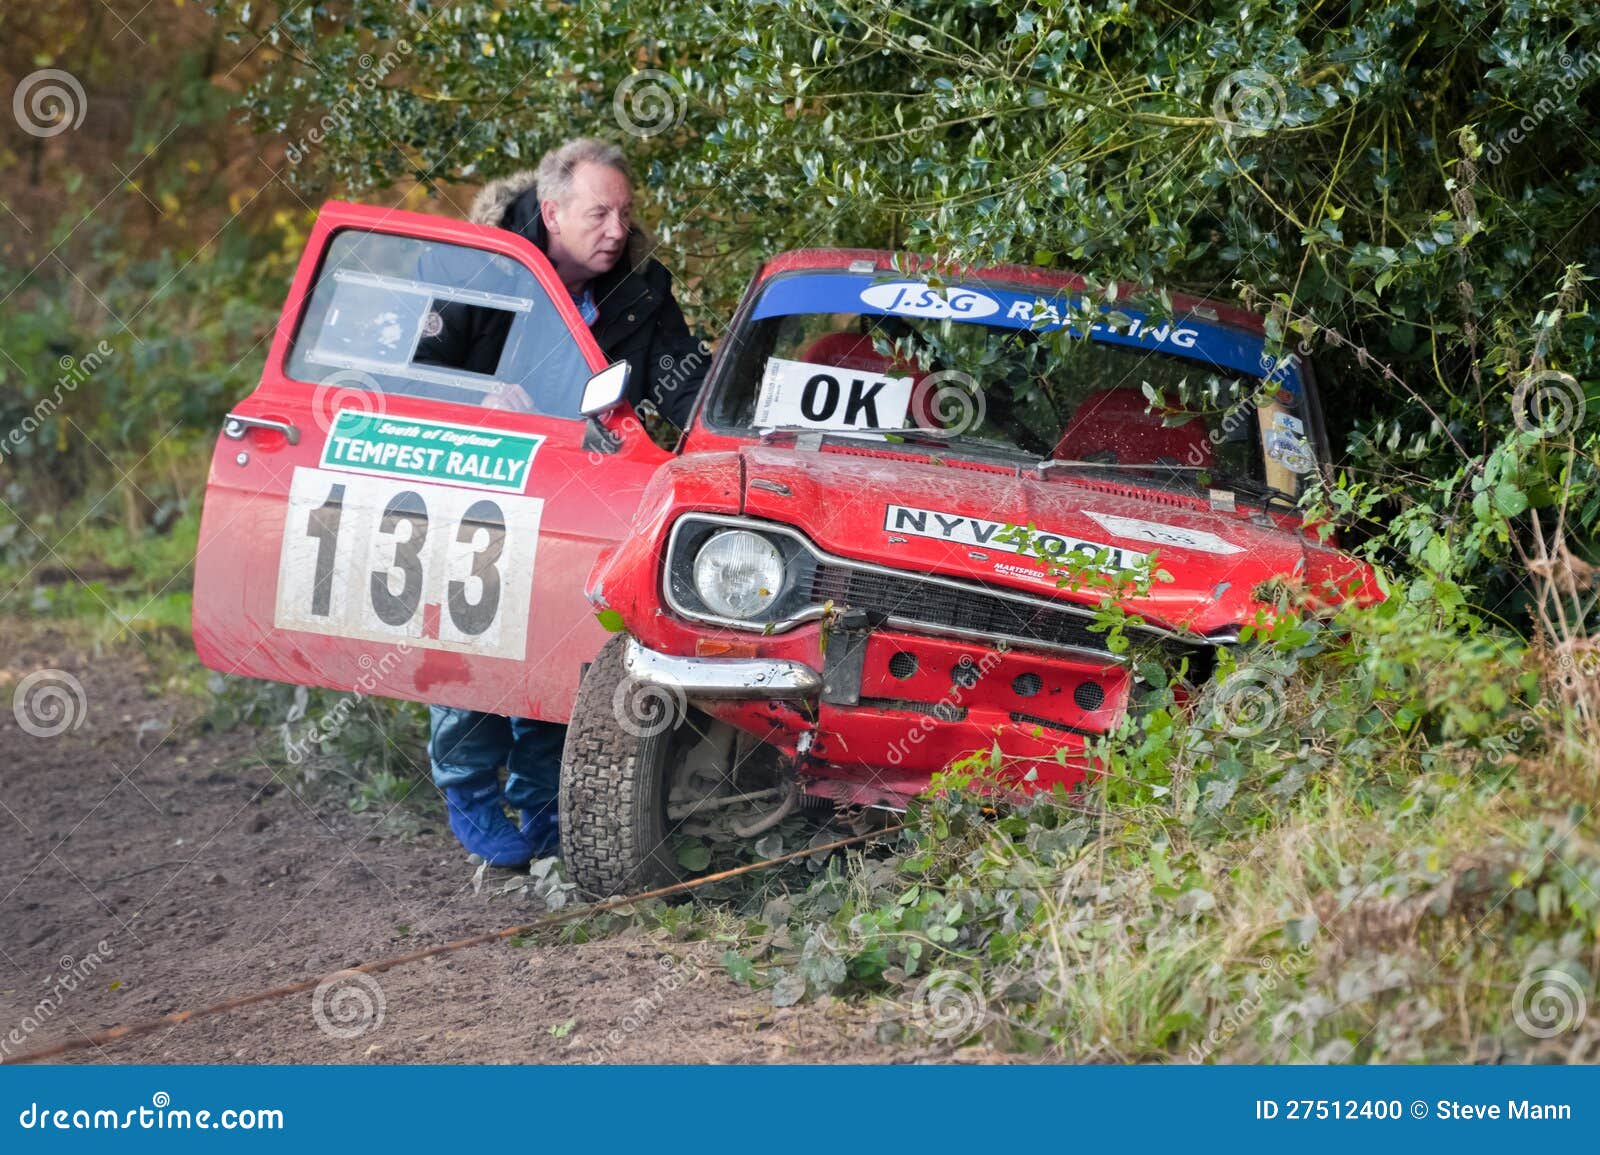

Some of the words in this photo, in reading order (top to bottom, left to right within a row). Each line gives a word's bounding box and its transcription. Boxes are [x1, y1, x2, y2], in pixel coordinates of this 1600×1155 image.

[886, 287, 977, 312] J.S.G
[1007, 300, 1198, 348] RAING
[801, 374, 886, 428] OK
[333, 436, 445, 472] TEMPEST
[445, 451, 526, 482] RALLY
[378, 422, 419, 439] South
[421, 428, 441, 441] of
[439, 430, 503, 448] England
[306, 483, 506, 635] 133
